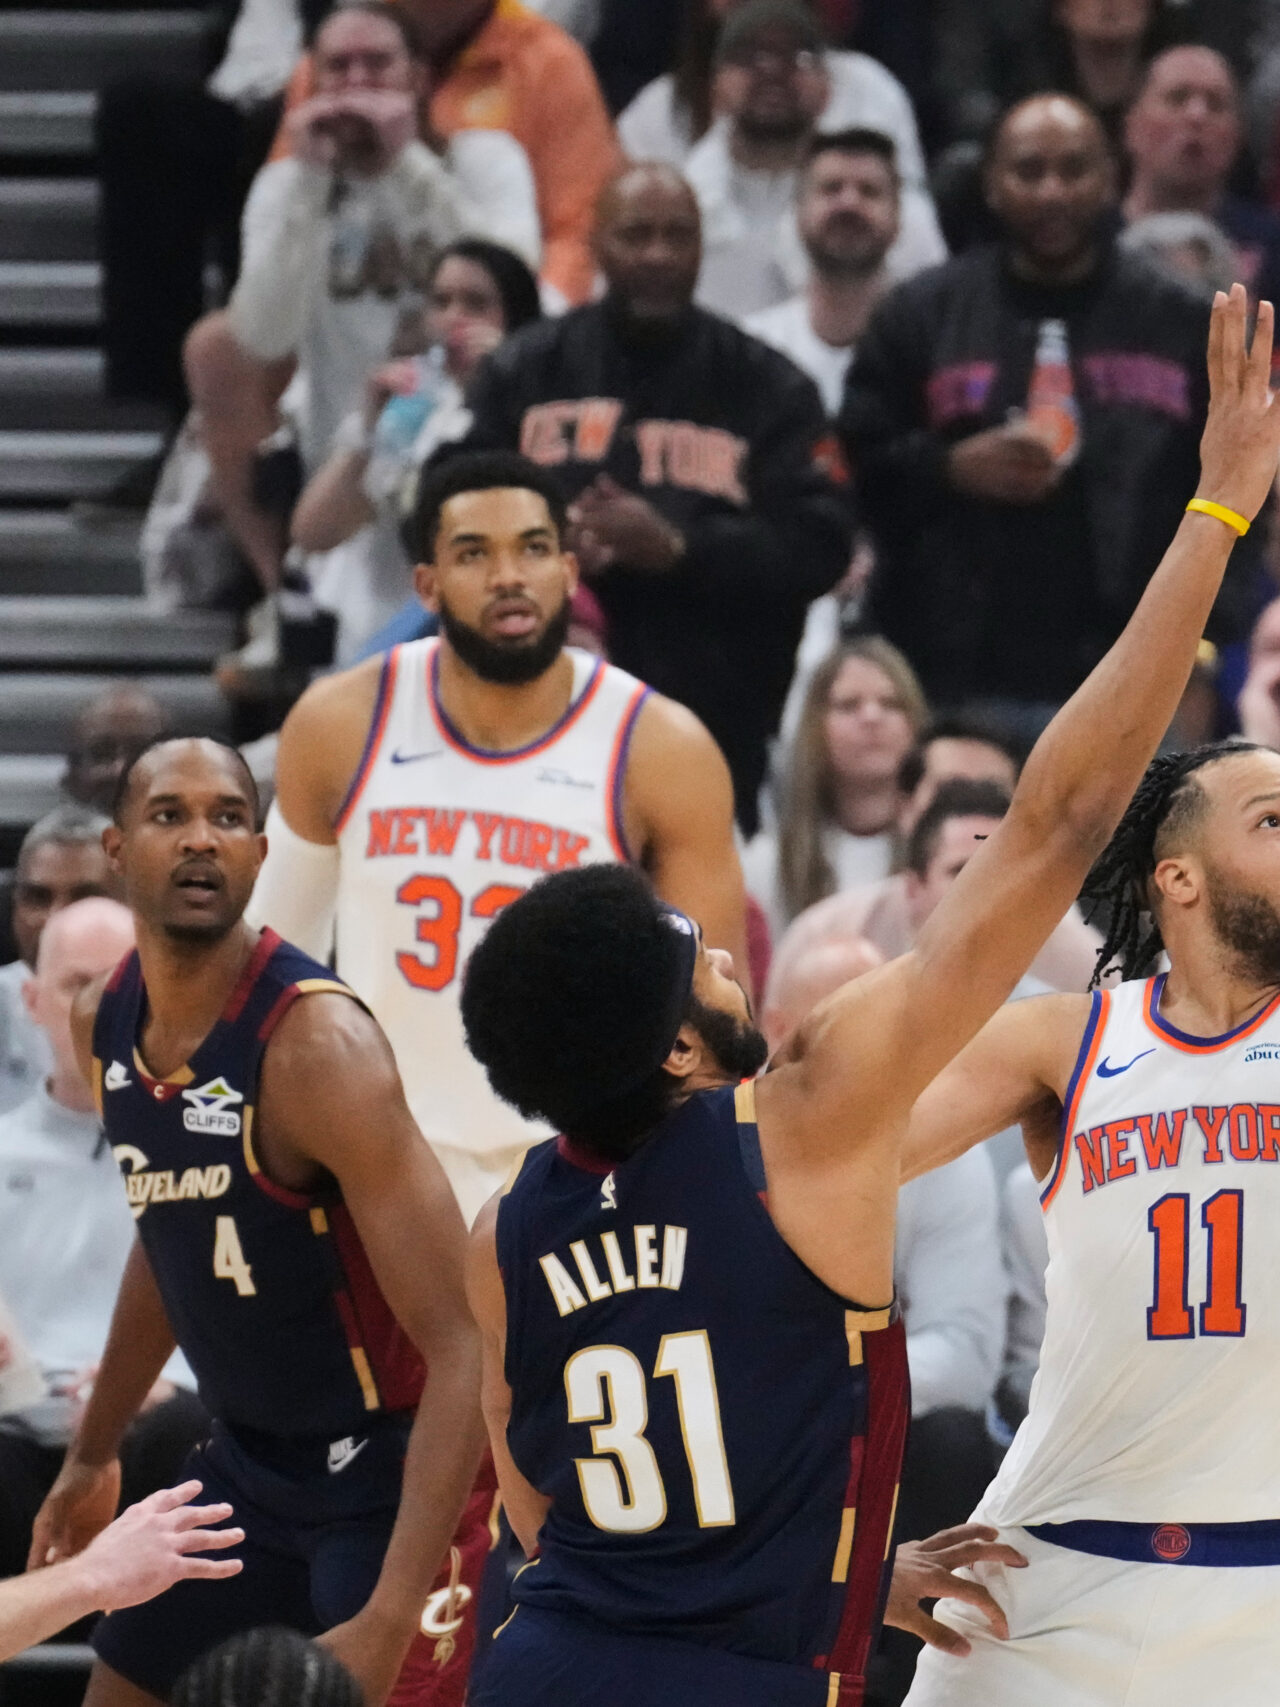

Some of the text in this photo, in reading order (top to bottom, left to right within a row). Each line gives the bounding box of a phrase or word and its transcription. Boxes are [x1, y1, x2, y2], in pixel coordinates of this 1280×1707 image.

[366, 806, 590, 873] NEW YORK
[396, 872, 528, 992] 3
[1244, 1050, 1272, 1062] abu
[185, 1112, 238, 1131] CLIFFS
[1074, 1108, 1188, 1194] NEW
[113, 1144, 231, 1220] CEVELAND
[213, 1215, 257, 1296] 4
[539, 1224, 688, 1318] ALLEN
[1146, 1188, 1247, 1341] 11
[563, 1328, 736, 1534] 31
